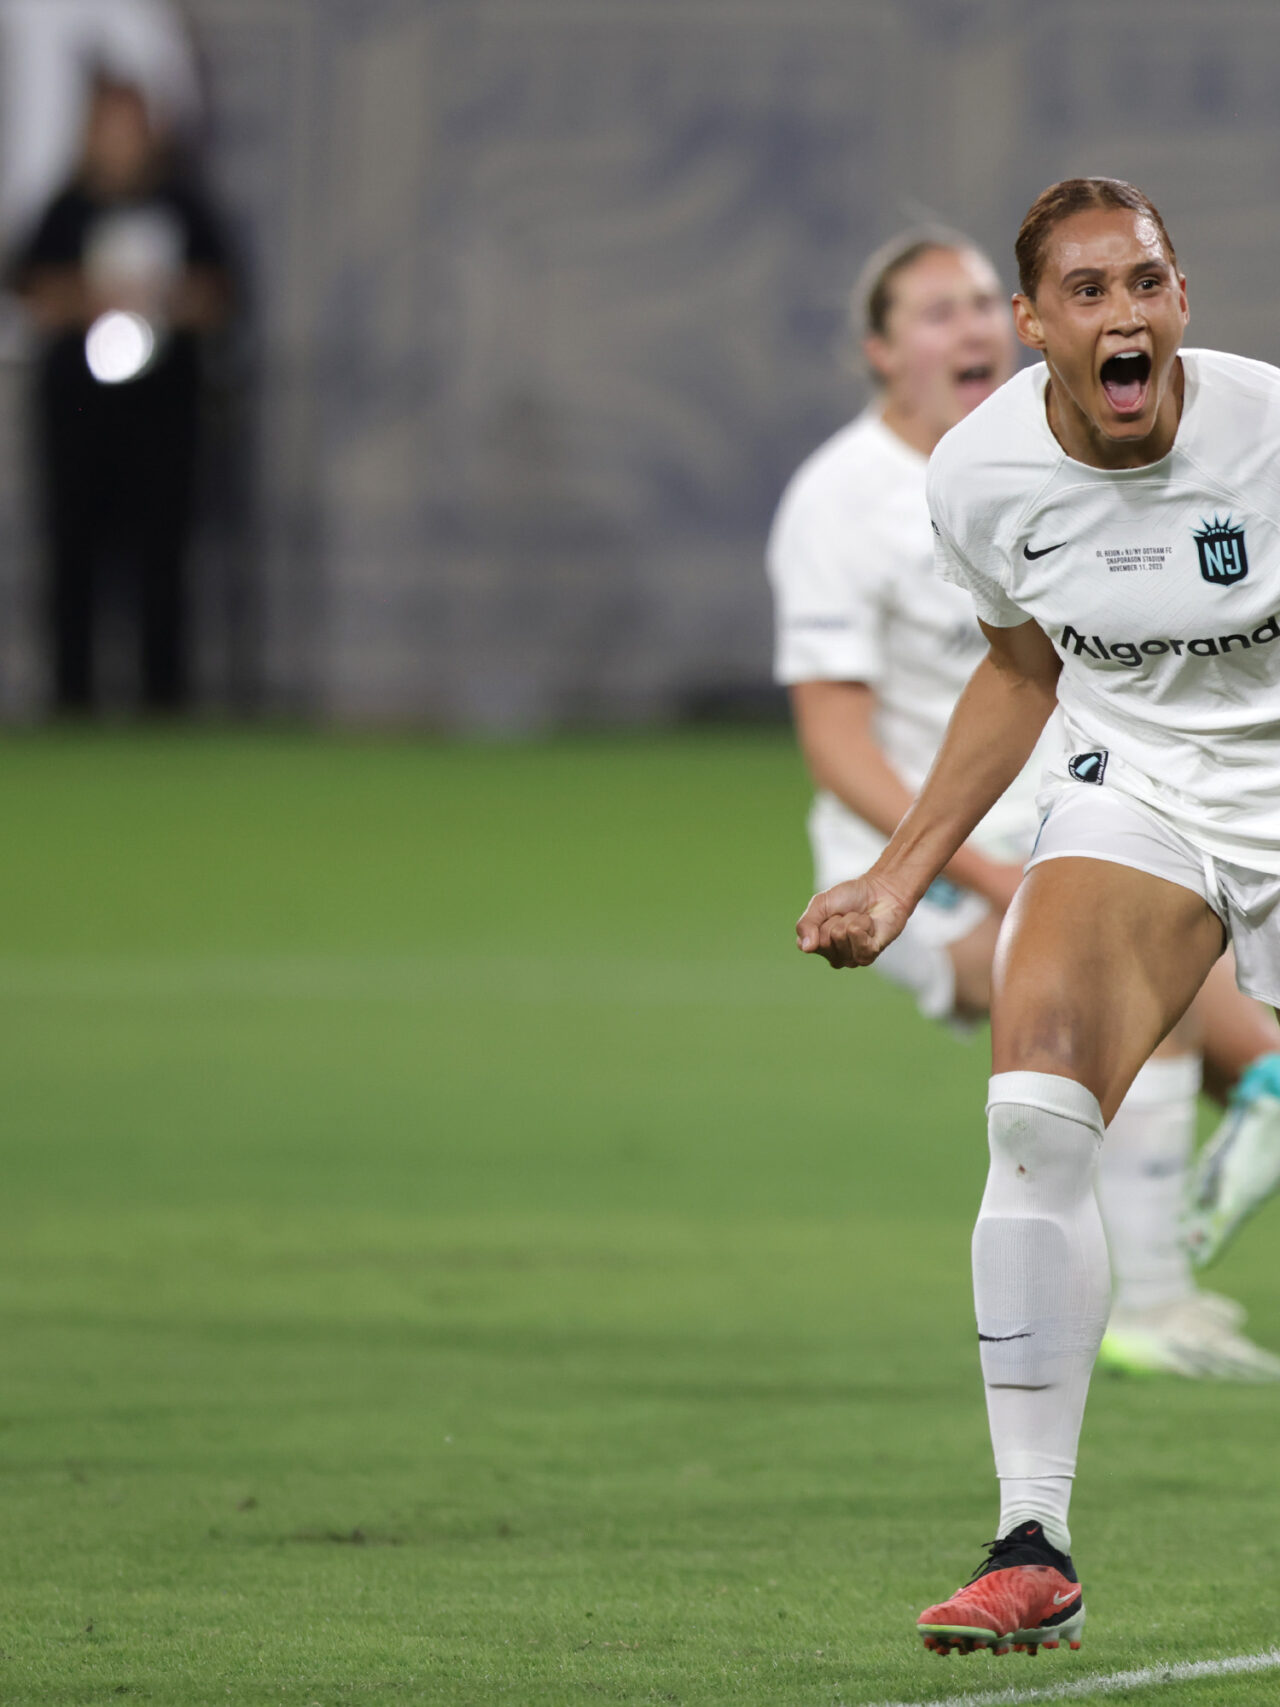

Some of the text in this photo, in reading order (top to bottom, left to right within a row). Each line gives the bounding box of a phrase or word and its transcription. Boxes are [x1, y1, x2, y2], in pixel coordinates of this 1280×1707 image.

[1104, 549, 1120, 558] REIGN
[1142, 547, 1165, 555] GOTHAM
[1165, 546, 1173, 554] FC
[1204, 539, 1241, 576] NY
[1106, 555, 1165, 565] SNAPDRAGON STADIUM
[1109, 564, 1138, 572] NOVEMBER
[1148, 563, 1163, 571] 2023
